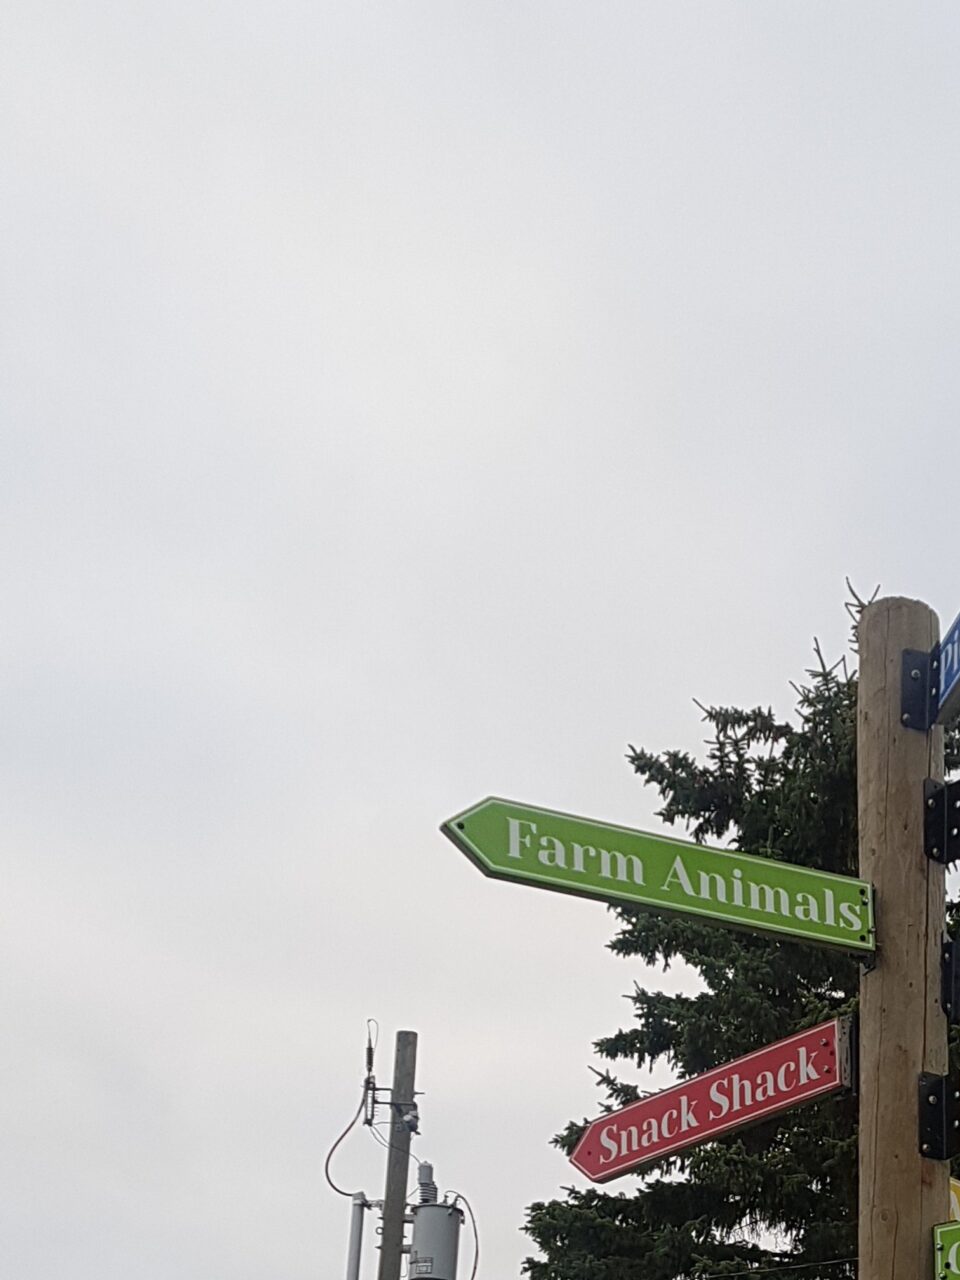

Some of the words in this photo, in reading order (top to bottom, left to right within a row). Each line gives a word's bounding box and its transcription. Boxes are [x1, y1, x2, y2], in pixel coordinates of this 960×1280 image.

[506, 817, 645, 886] Farm
[661, 855, 862, 931] Animals
[599, 1096, 700, 1163] Snack
[708, 1047, 820, 1121] Shack
